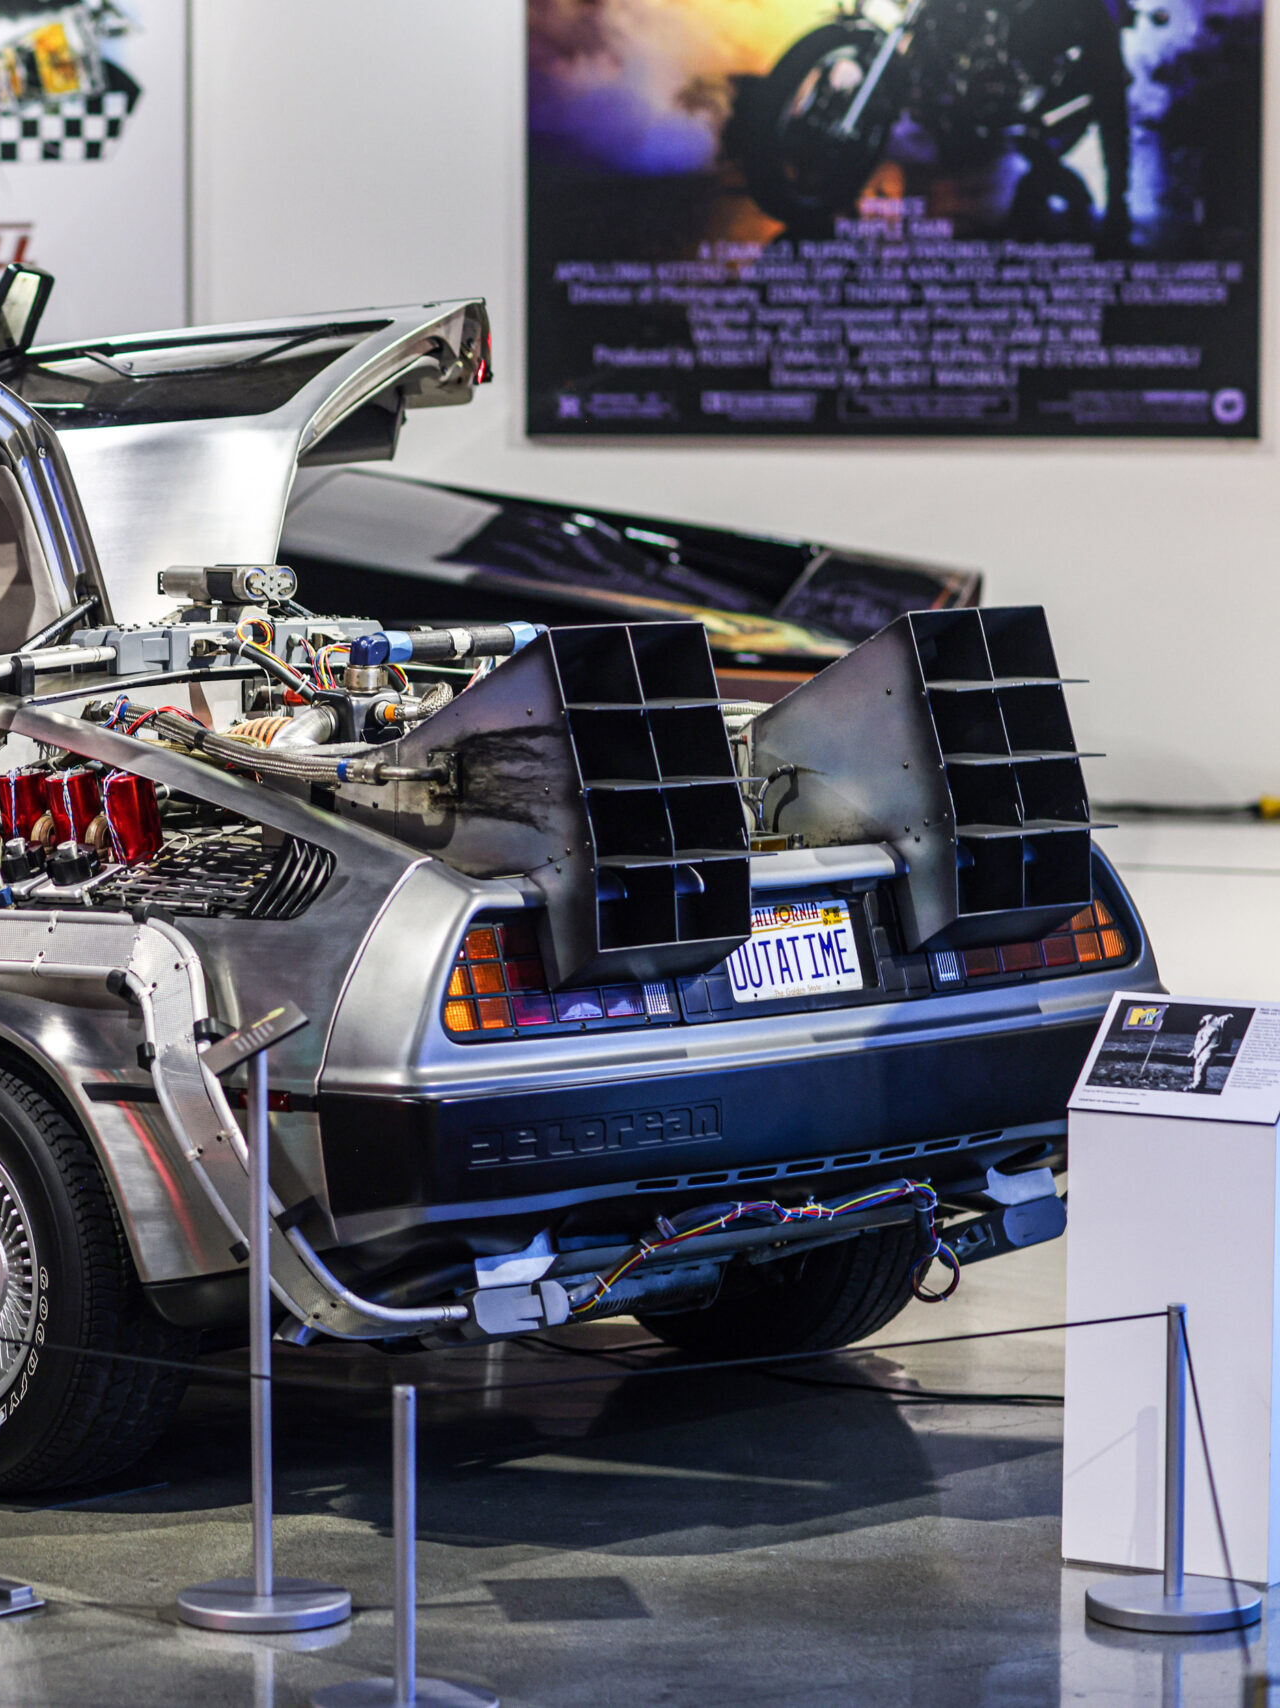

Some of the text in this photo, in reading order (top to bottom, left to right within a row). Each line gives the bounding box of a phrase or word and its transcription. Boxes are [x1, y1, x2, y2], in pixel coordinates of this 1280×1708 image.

[751, 902, 819, 927] ALIFORNIA
[728, 929, 856, 991] OUTATIME
[1128, 1007, 1161, 1026] MTV
